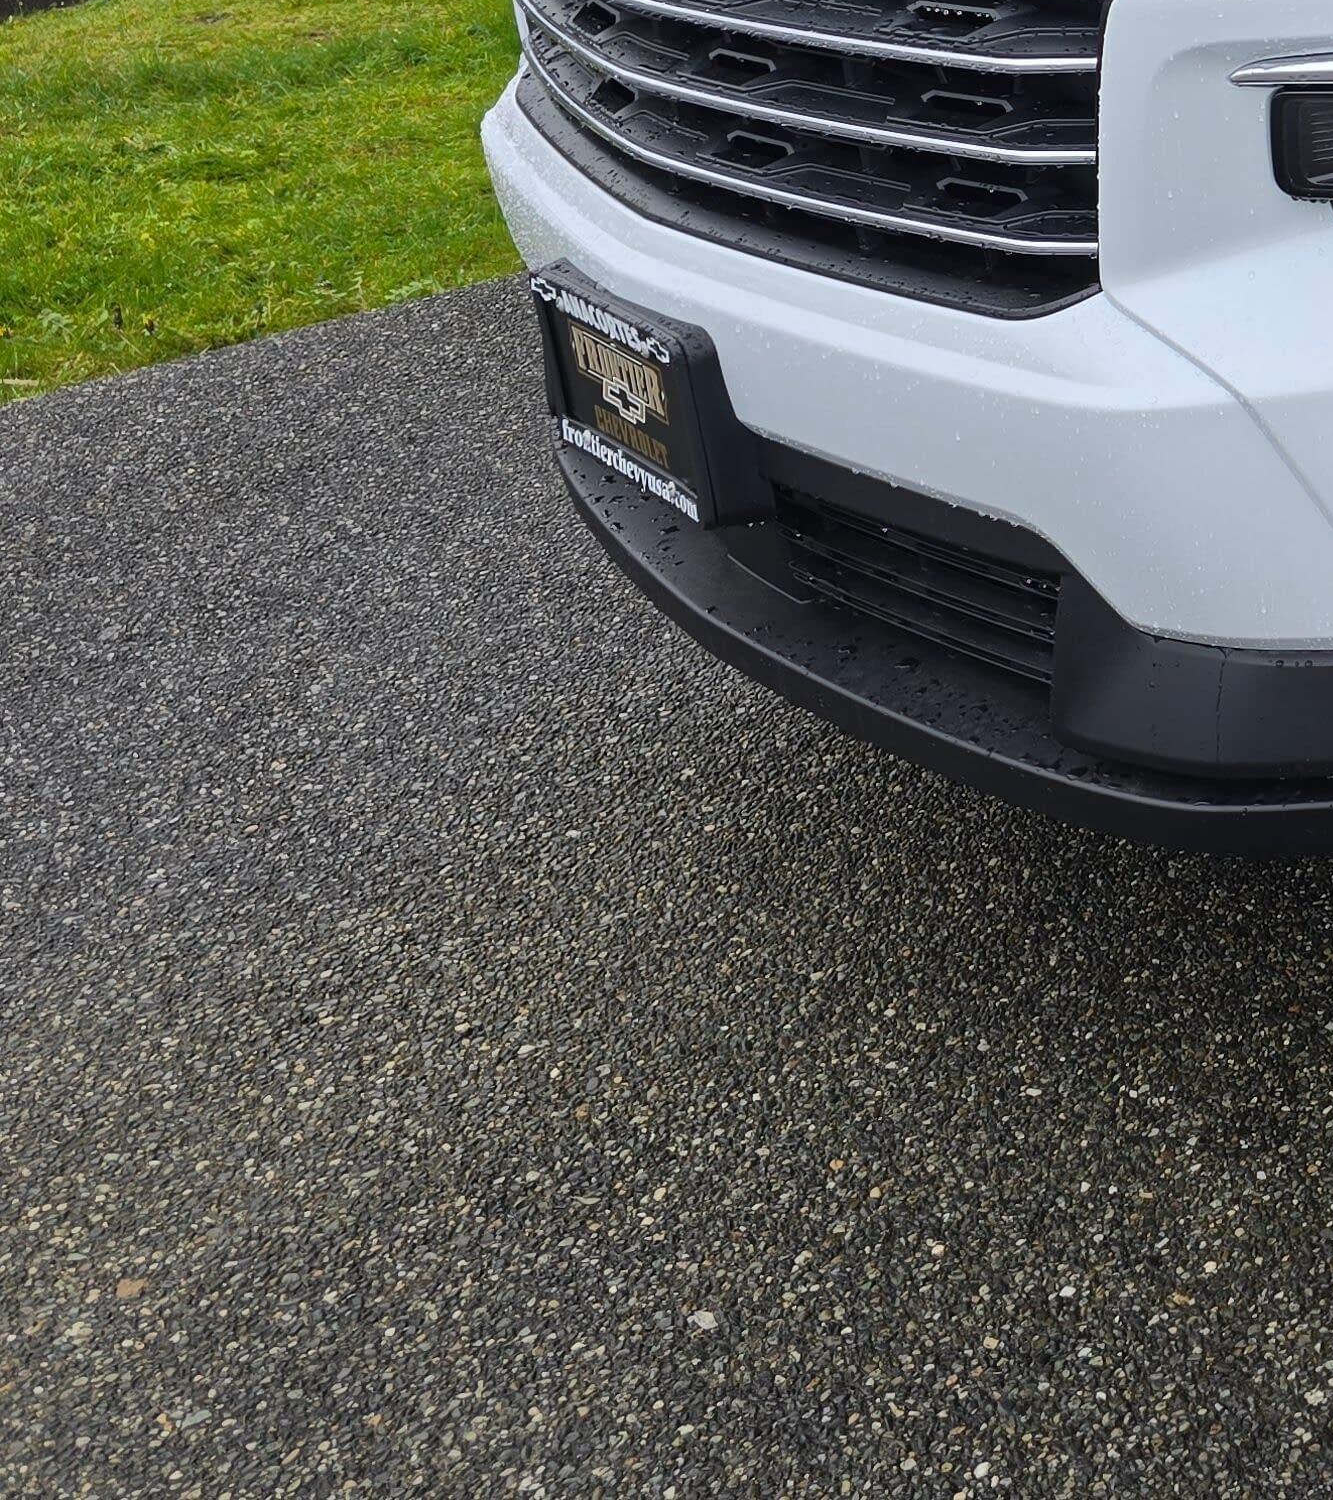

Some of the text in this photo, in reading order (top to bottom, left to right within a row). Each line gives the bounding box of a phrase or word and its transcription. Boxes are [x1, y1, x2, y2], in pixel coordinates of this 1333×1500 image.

[560, 289, 642, 352] ANACORTES
[570, 323, 666, 417] FRONTIER
[593, 404, 671, 470] CHEVROLET
